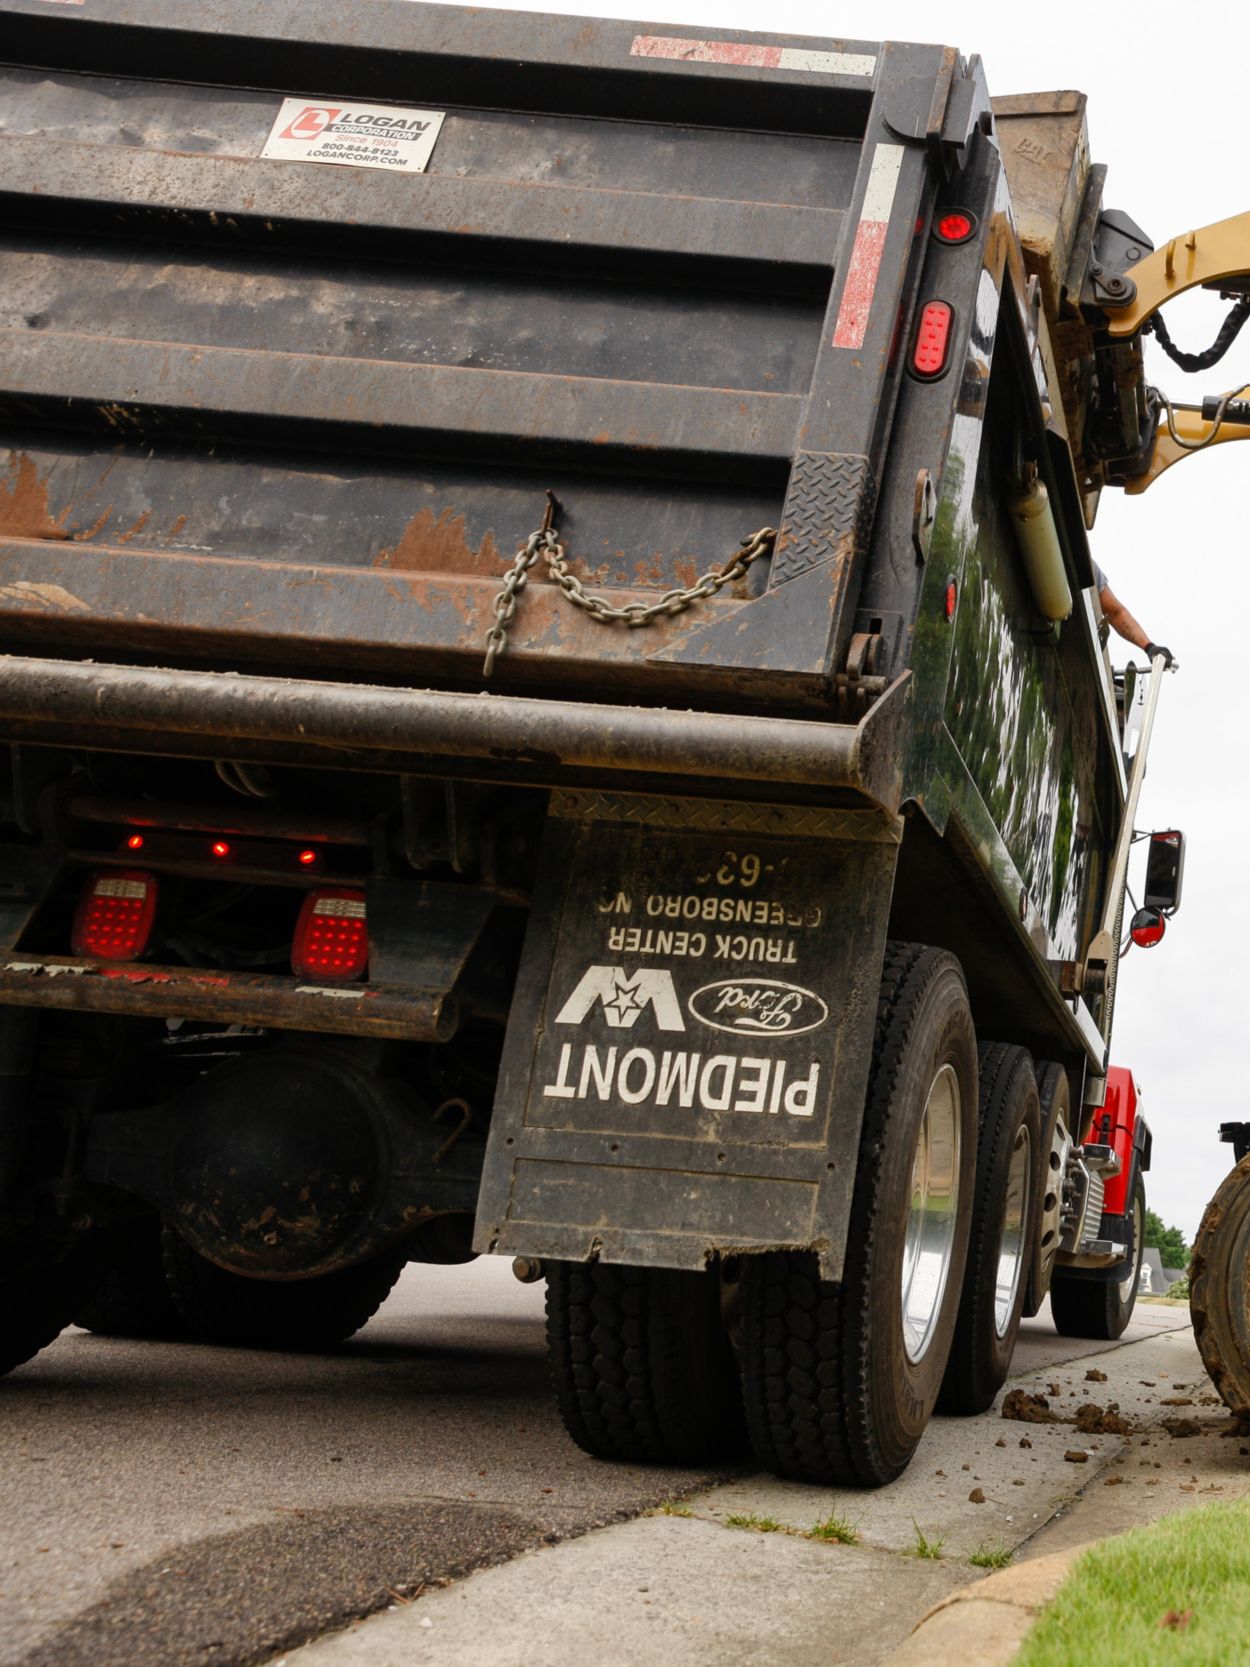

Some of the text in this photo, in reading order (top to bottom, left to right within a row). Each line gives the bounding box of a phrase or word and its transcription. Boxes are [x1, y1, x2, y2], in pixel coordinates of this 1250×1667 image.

[340, 113, 431, 132] LOGAN
[331, 125, 416, 140] CORPORATION
[335, 133, 399, 147] Since 1904
[306, 150, 408, 166] LOGANCORP.COM
[321, 143, 399, 157] 800-844-8123
[607, 927, 798, 964] TRUCK CENTER
[716, 986, 802, 1028] Ford
[543, 1043, 820, 1117] PIEDMONT
